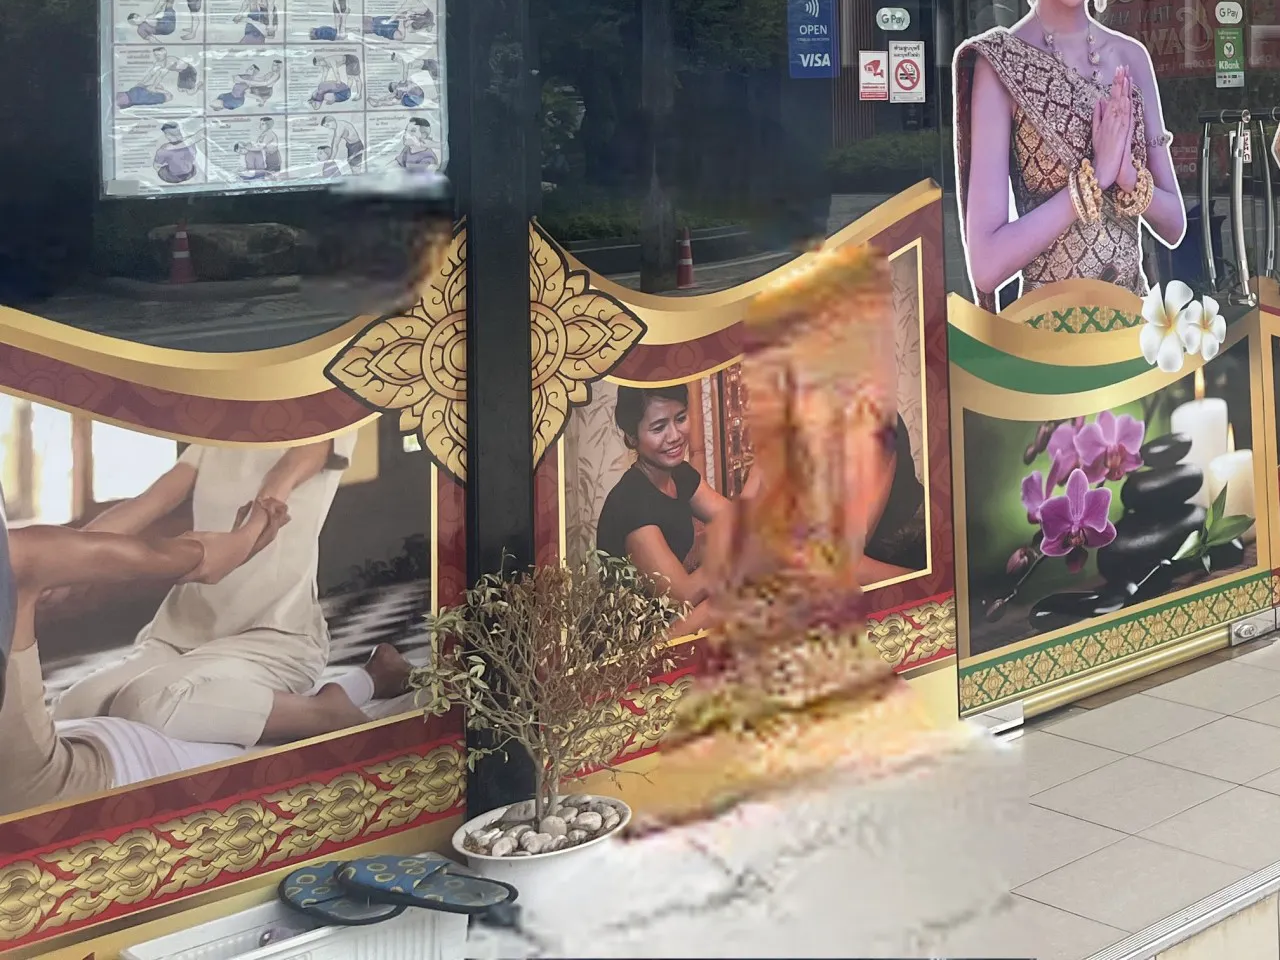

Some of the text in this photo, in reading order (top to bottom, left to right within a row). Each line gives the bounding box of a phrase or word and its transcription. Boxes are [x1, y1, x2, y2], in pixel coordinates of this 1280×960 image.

[1227, 9, 1239, 19] Pay
[891, 14, 906, 26] Pay
[799, 24, 828, 35] OPEN
[799, 53, 831, 68] VISA
[1219, 59, 1241, 70] KBank
